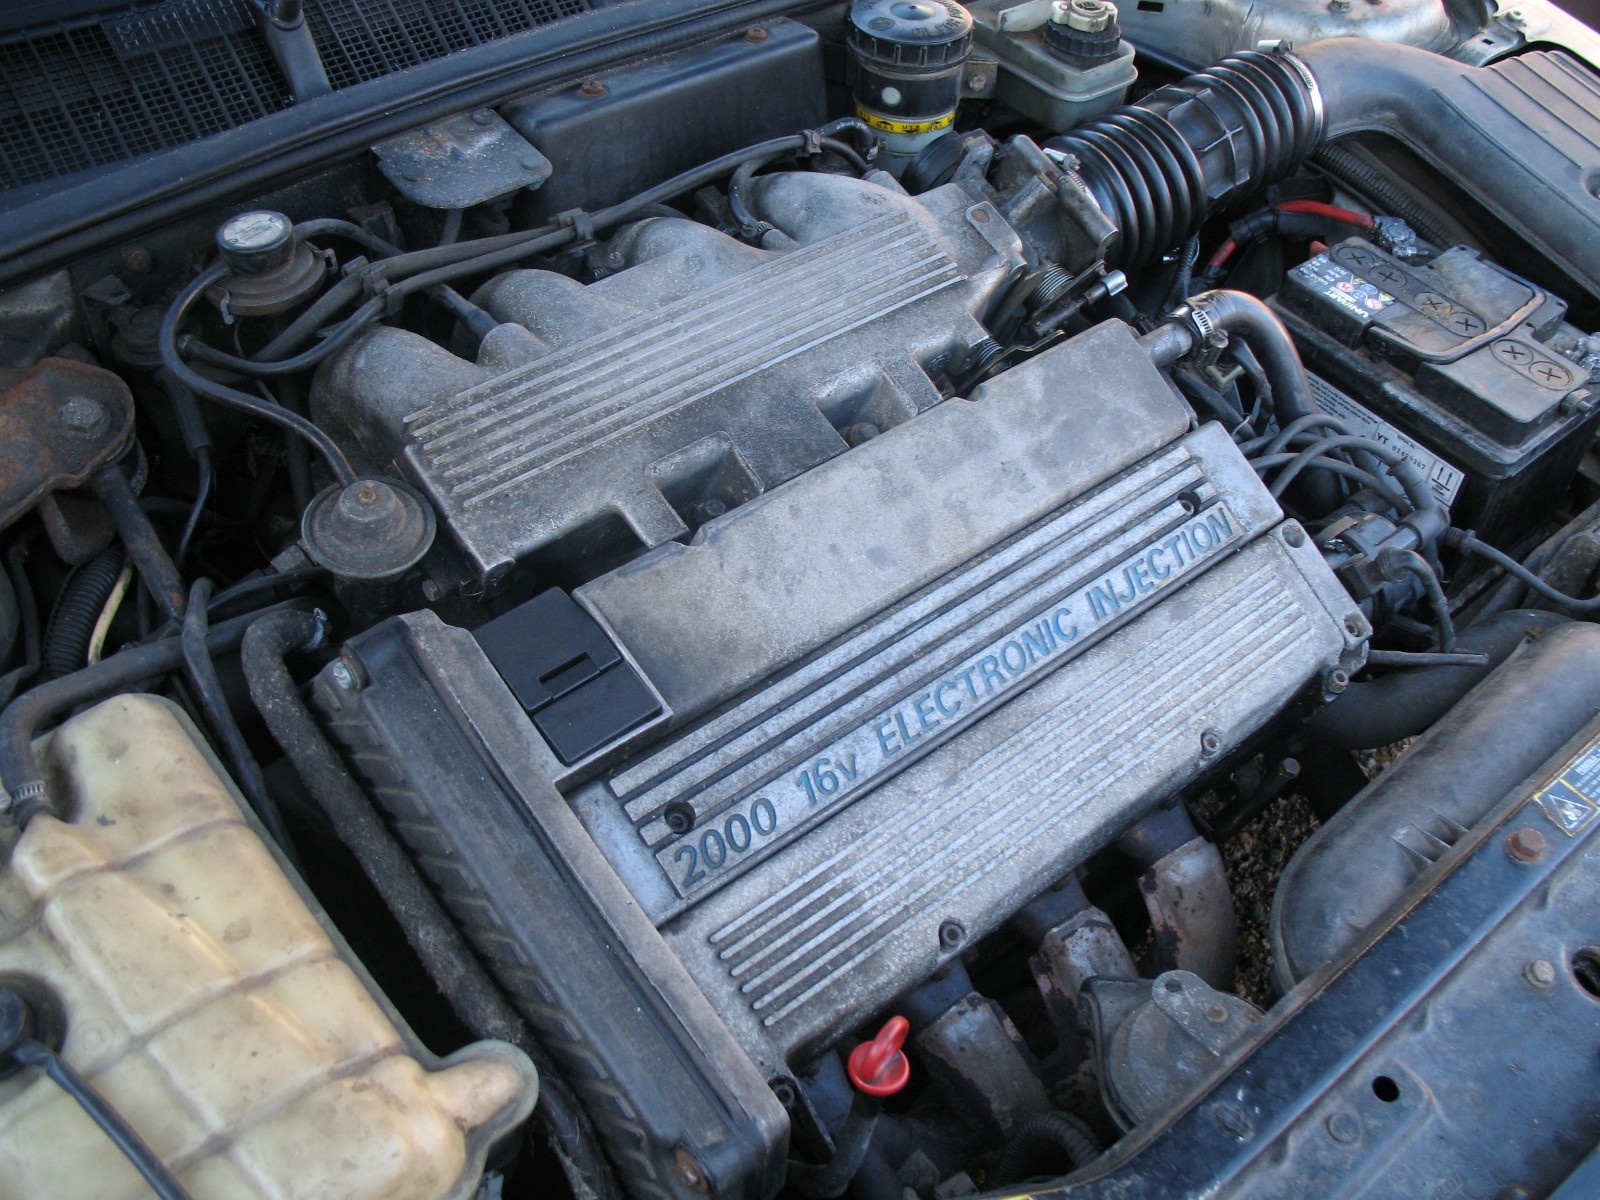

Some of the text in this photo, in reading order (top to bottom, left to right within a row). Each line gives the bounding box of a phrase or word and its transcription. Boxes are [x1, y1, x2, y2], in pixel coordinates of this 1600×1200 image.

[876, 121, 895, 132] MAX
[1323, 290, 1369, 318] UNIPART
[1377, 433, 1389, 445] YT
[674, 507, 1235, 887] 2000 16v ELECTRONIC INJECTION
